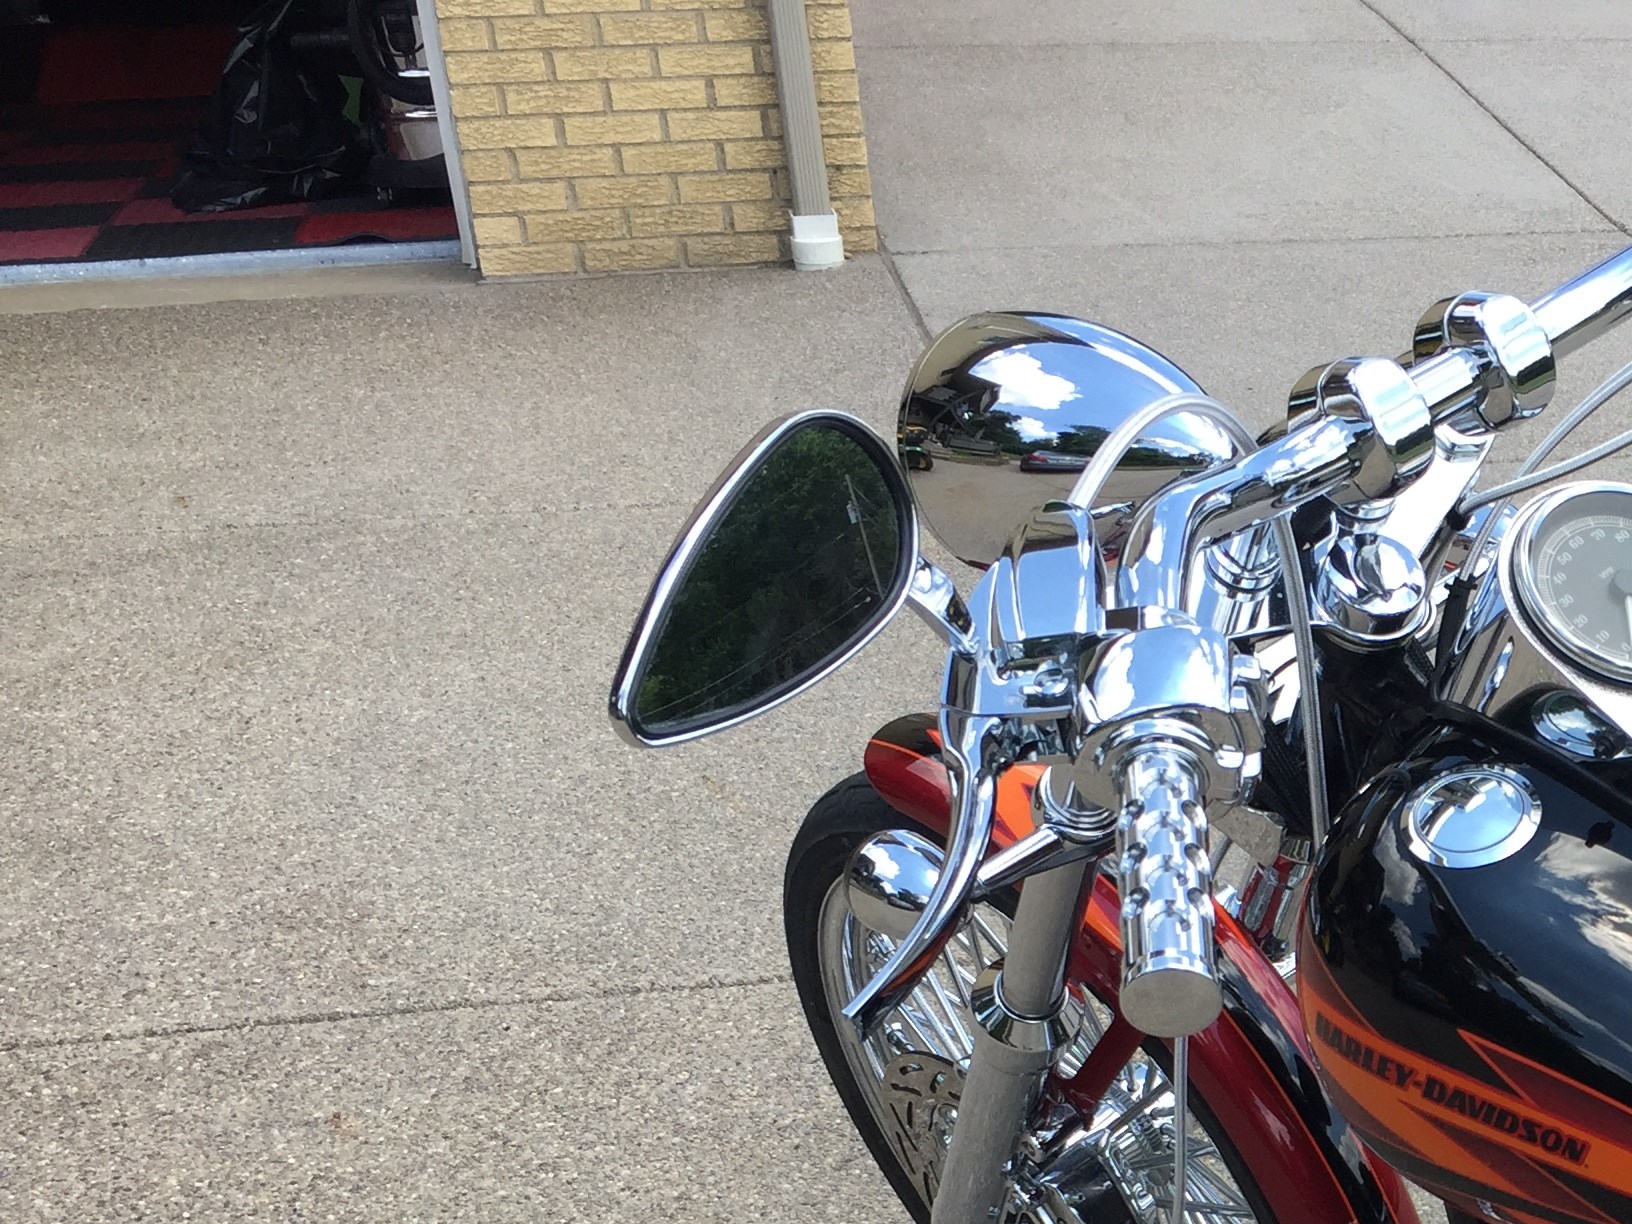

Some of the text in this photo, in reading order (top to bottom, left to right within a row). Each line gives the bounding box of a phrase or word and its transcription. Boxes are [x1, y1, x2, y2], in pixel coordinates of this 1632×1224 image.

[1590, 528, 1606, 541] 70
[1614, 529, 1630, 543] 80
[1568, 535, 1584, 549] 60
[1553, 571, 1567, 584] 40
[1573, 614, 1588, 628] 20
[1596, 629, 1610, 643] 10
[1315, 1010, 1587, 1163] HARLEY-DAVIDSON
